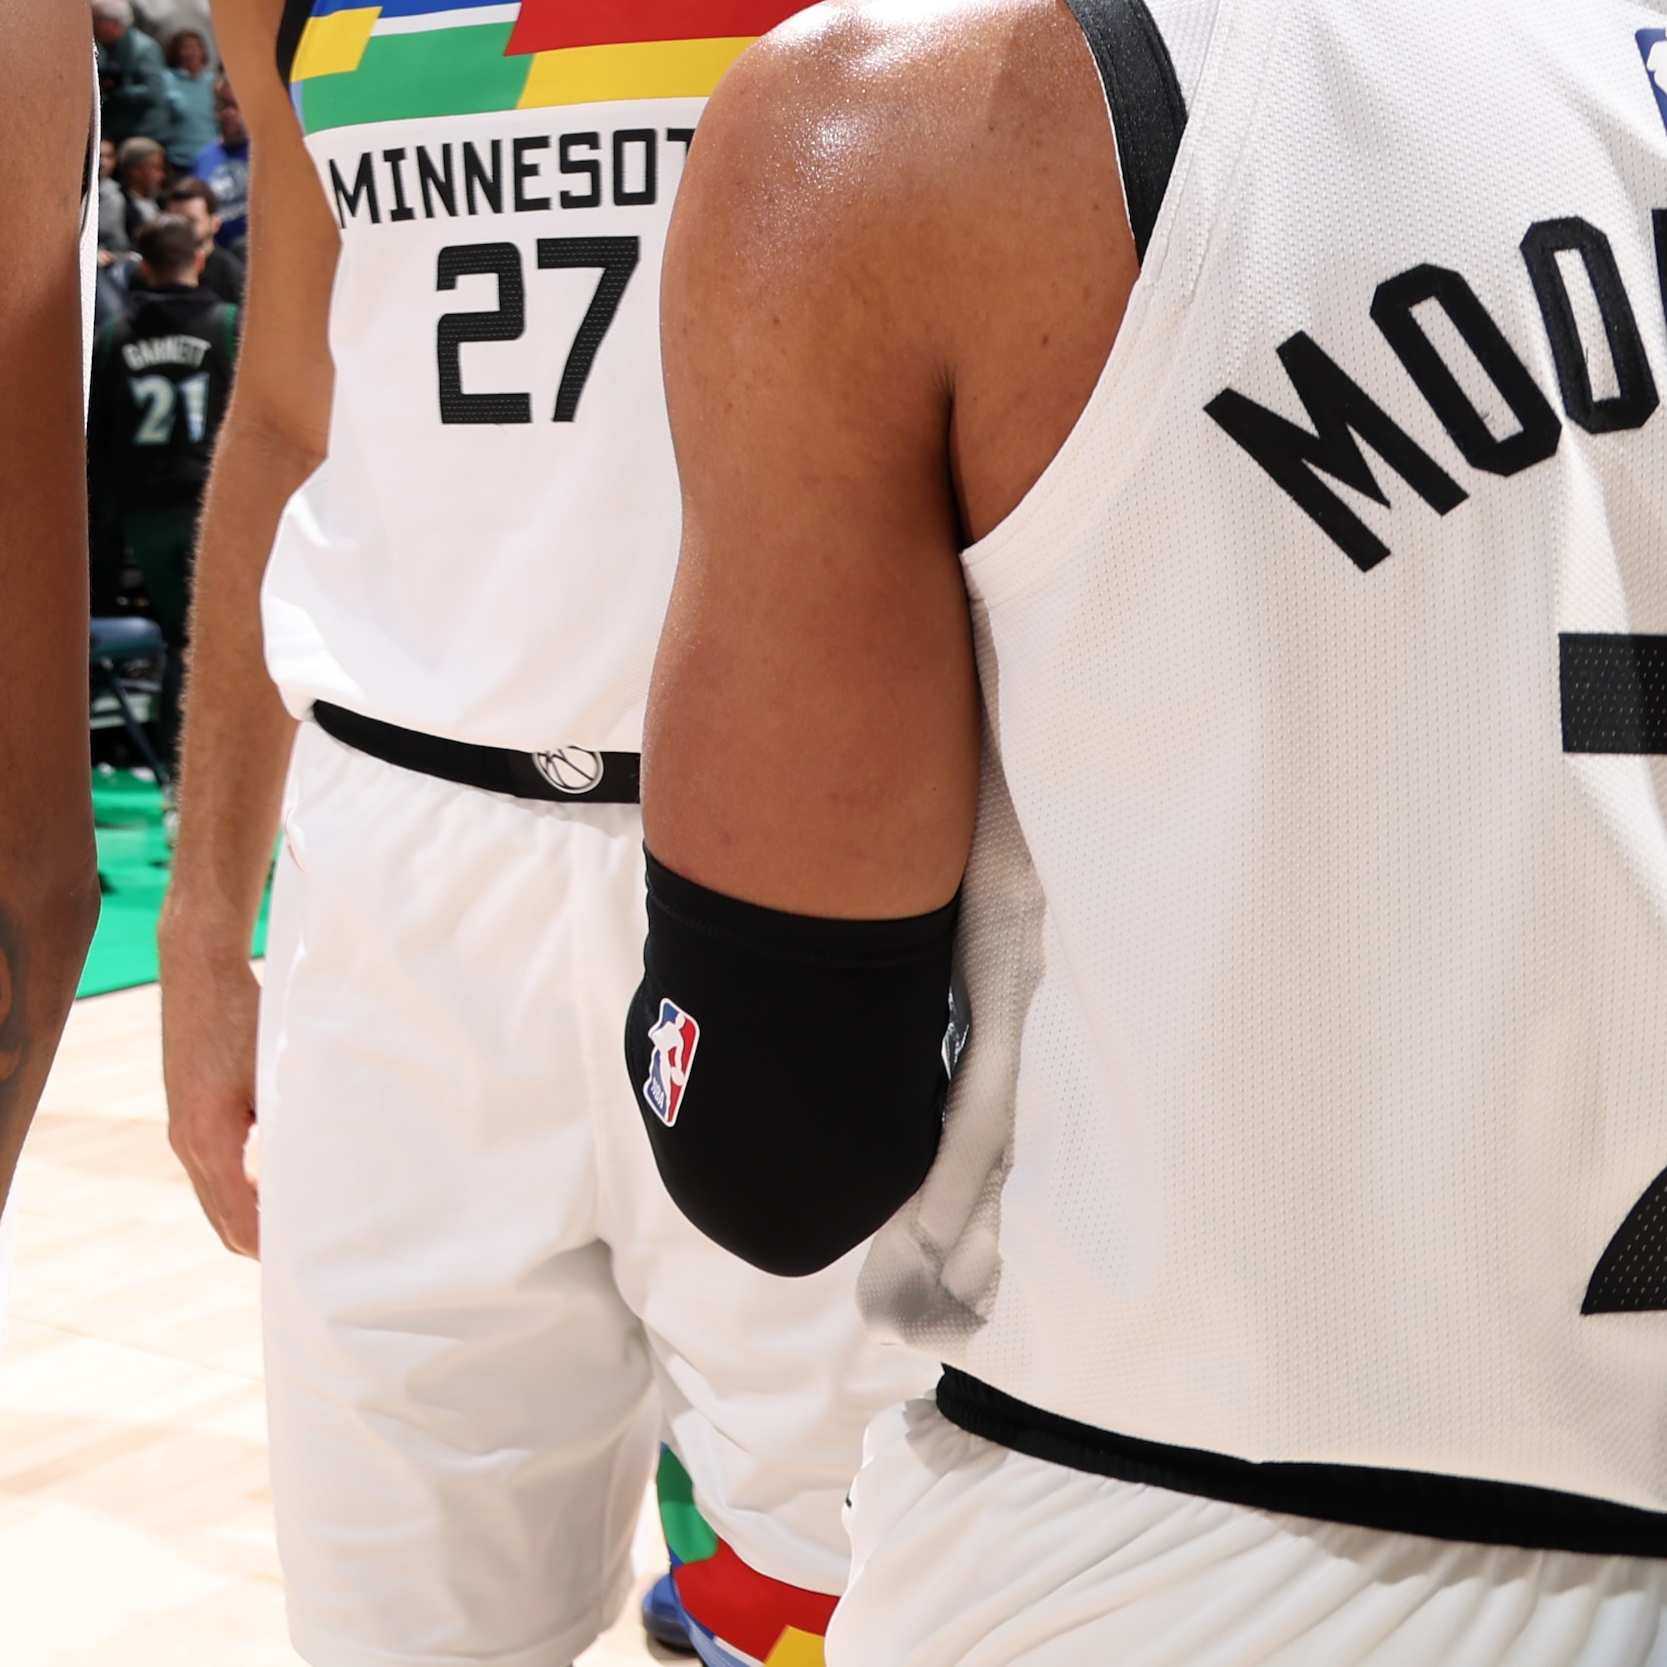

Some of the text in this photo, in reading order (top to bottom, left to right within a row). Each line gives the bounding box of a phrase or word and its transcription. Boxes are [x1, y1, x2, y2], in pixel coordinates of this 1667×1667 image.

[121, 334, 212, 371] GARNETT
[437, 235, 639, 424] 27
[1203, 208, 1667, 573] MOO
[128, 371, 210, 445] 21
